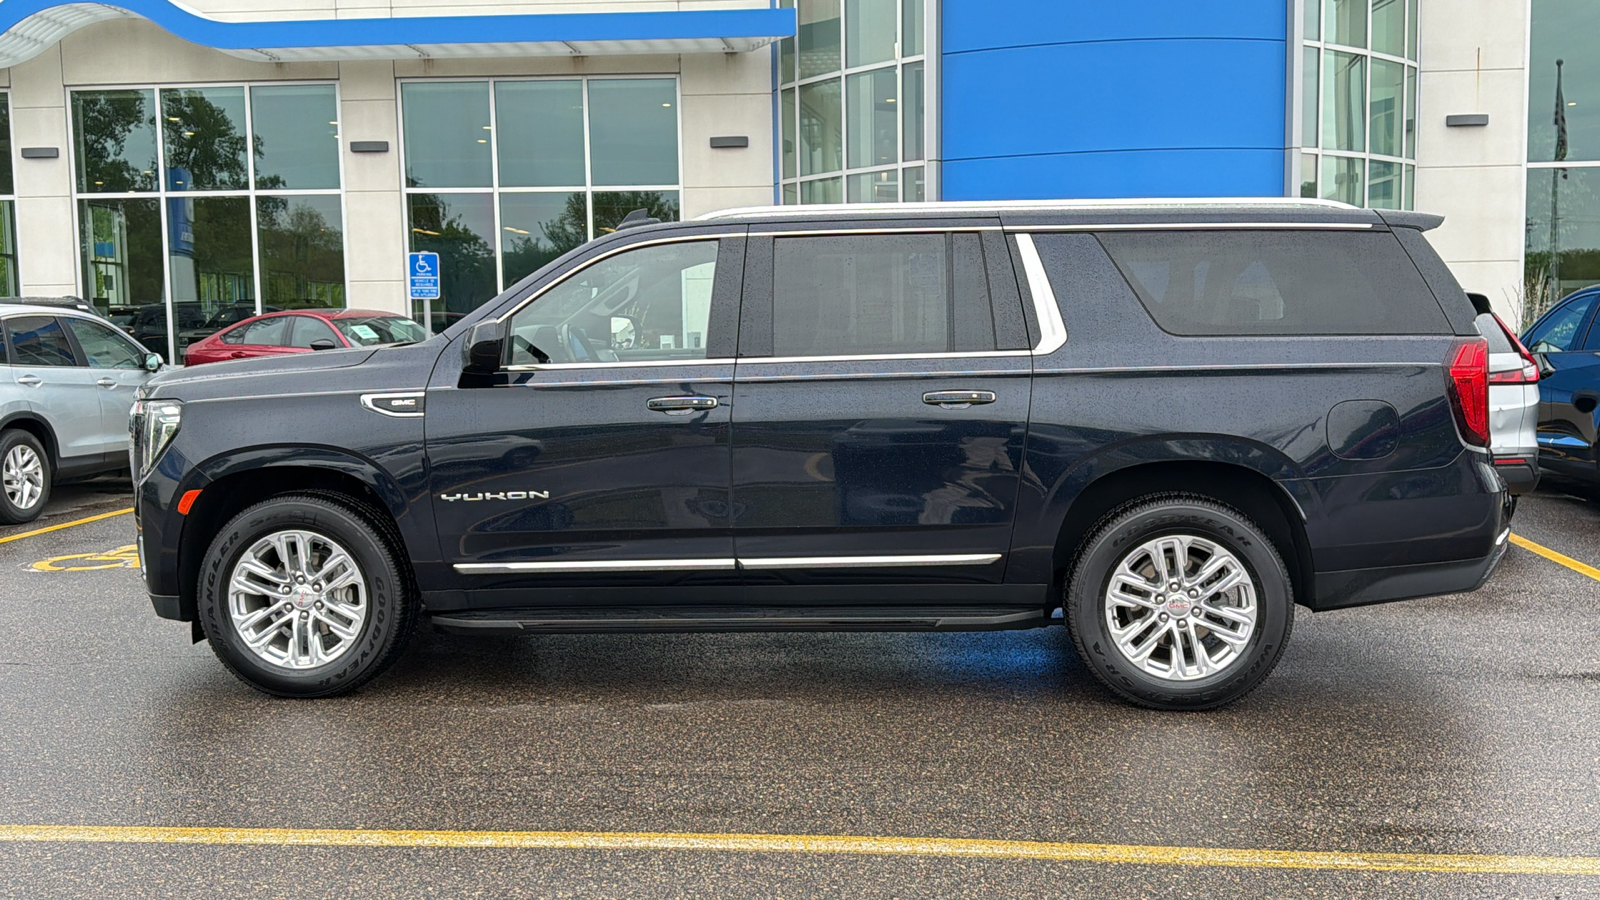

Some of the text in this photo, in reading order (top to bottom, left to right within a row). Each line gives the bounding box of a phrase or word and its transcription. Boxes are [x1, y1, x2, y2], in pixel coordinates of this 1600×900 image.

[440, 490, 550, 502] YUKON
[205, 530, 241, 651] WRANGLER
[317, 576, 387, 686] GOODYEAR
